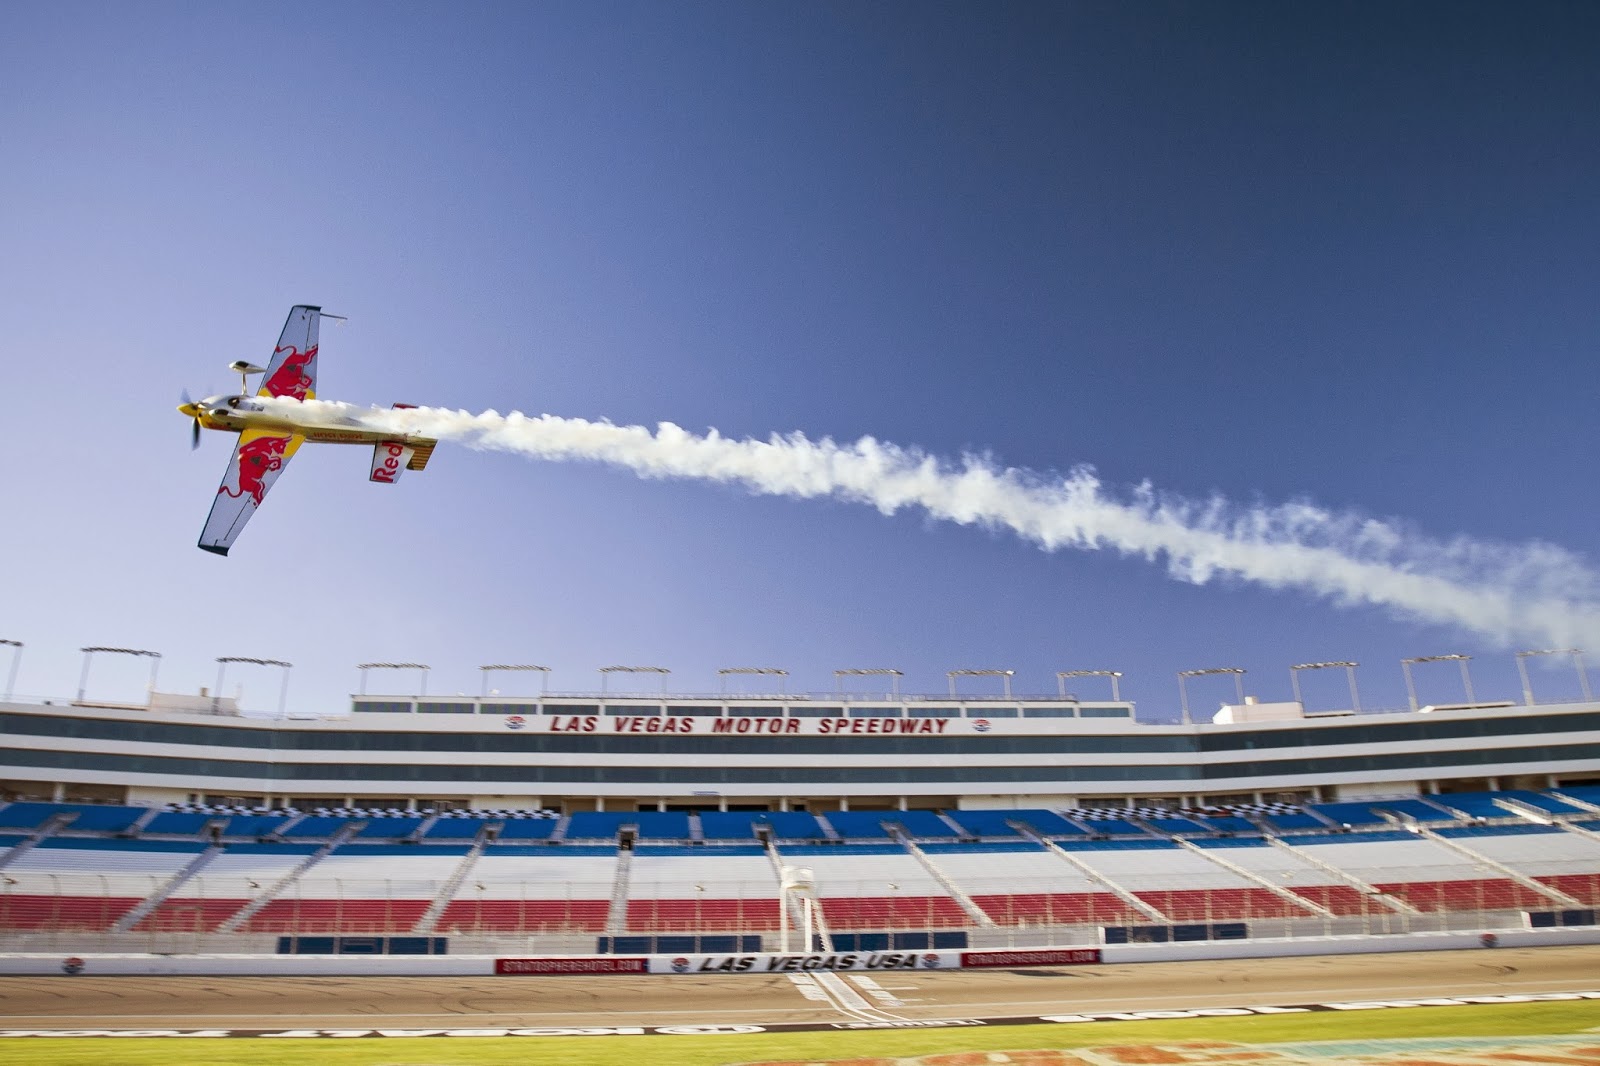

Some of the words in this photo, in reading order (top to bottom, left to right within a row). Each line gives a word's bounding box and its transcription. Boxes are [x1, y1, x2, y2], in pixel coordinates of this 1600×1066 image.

[372, 441, 403, 483] Red
[549, 716, 598, 732] LAS
[614, 716, 693, 733] VEGAS
[712, 717, 801, 734] MOTOR
[818, 717, 950, 735] SPEEDWAY
[698, 957, 757, 972] LAS
[766, 954, 858, 971] VEGAS
[865, 953, 917, 969] USA
